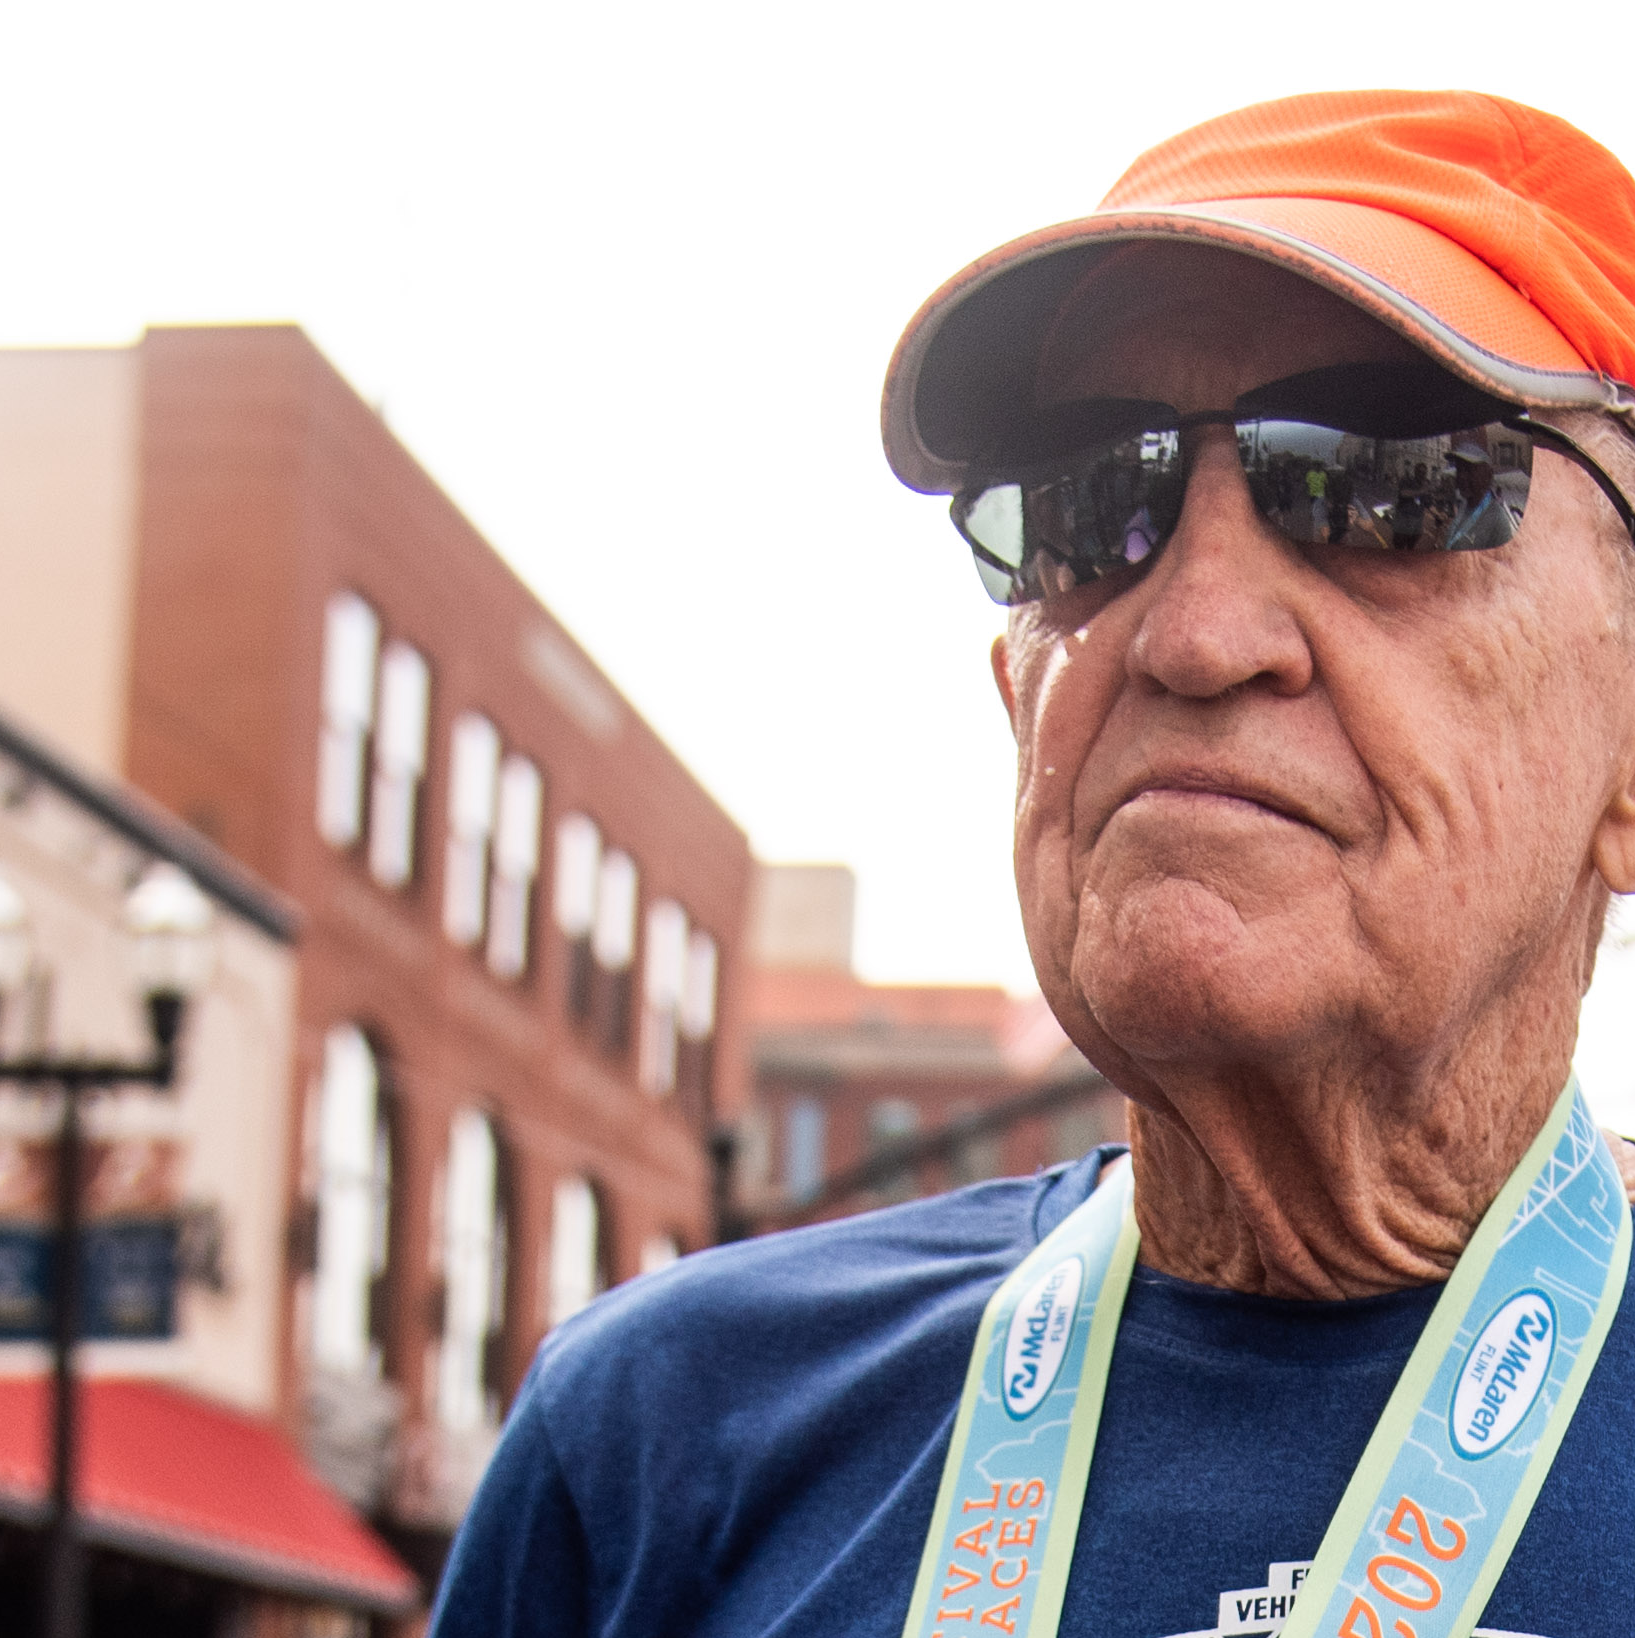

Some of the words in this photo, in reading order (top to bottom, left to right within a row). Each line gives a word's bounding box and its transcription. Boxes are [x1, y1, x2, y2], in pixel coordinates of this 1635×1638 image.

[1020, 1268, 1068, 1358] McLaren
[1051, 1305, 1068, 1342] FLINT
[1467, 1340, 1531, 1442] McLaren
[1470, 1344, 1496, 1383] FLINT
